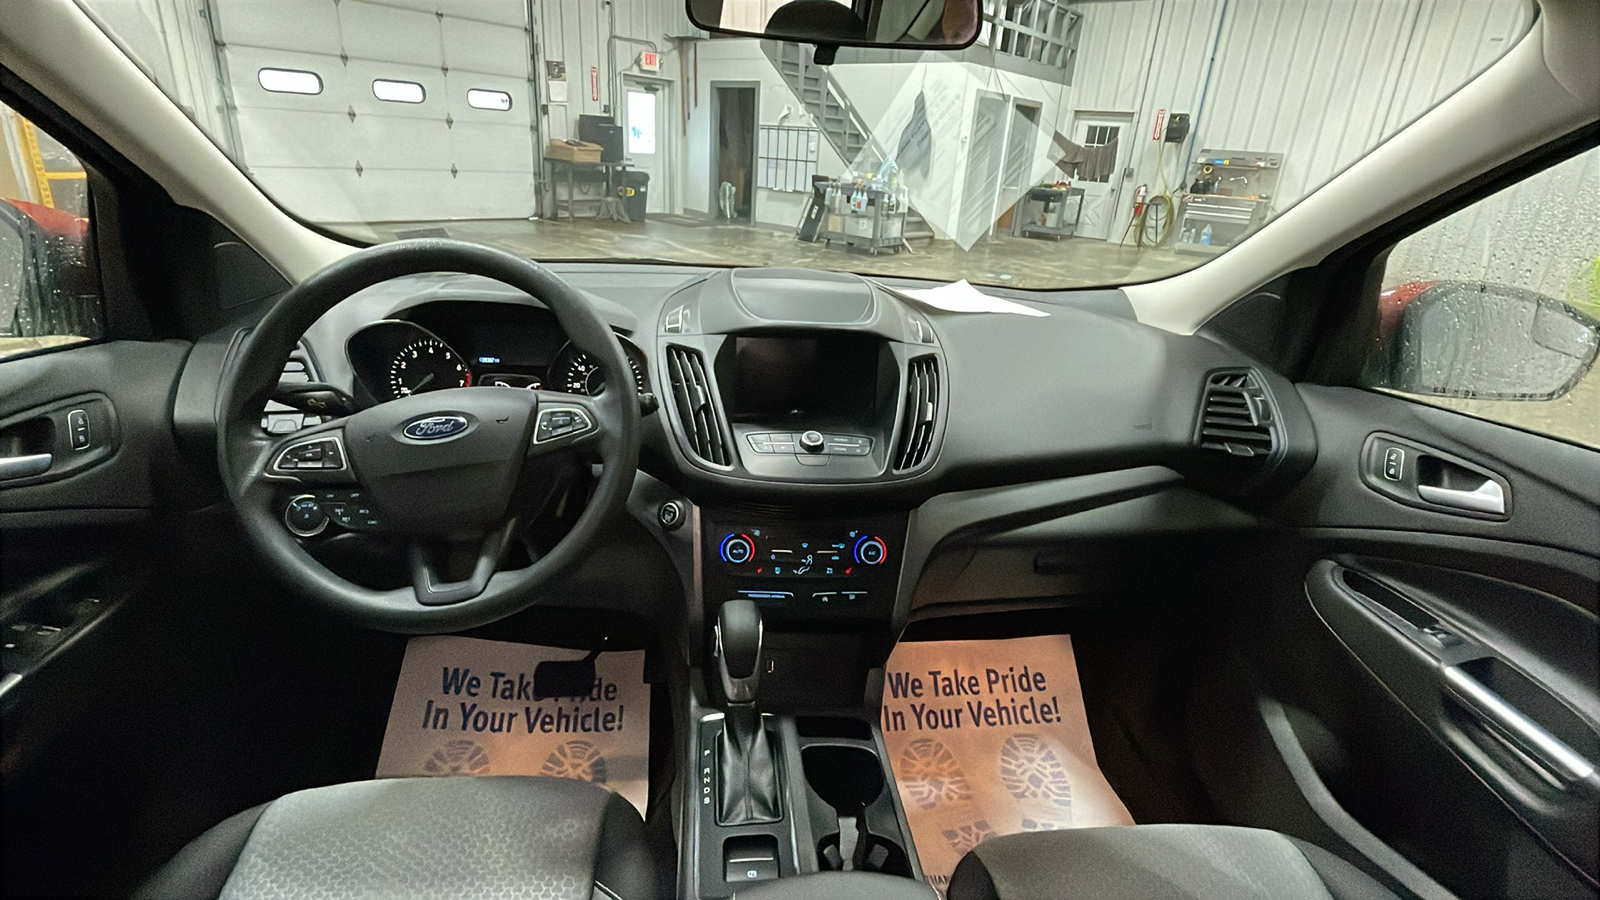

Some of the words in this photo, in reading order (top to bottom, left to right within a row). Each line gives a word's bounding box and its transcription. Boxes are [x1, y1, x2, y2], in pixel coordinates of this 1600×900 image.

[412, 350, 418, 358] 3
[428, 346, 434, 354] 4
[401, 361, 406, 369] 2
[416, 418, 455, 435] Ford
[442, 666, 481, 698] We
[490, 671, 542, 702] Tak
[887, 671, 924, 699] We
[928, 668, 980, 698] Take
[985, 665, 1047, 695] Pride
[421, 700, 450, 730] In
[459, 702, 518, 733] Your
[524, 704, 625, 734] Vehicle!
[883, 704, 906, 732] In
[909, 702, 963, 731] Your
[966, 696, 1062, 728] Vehicle!
[704, 776, 710, 784] N
